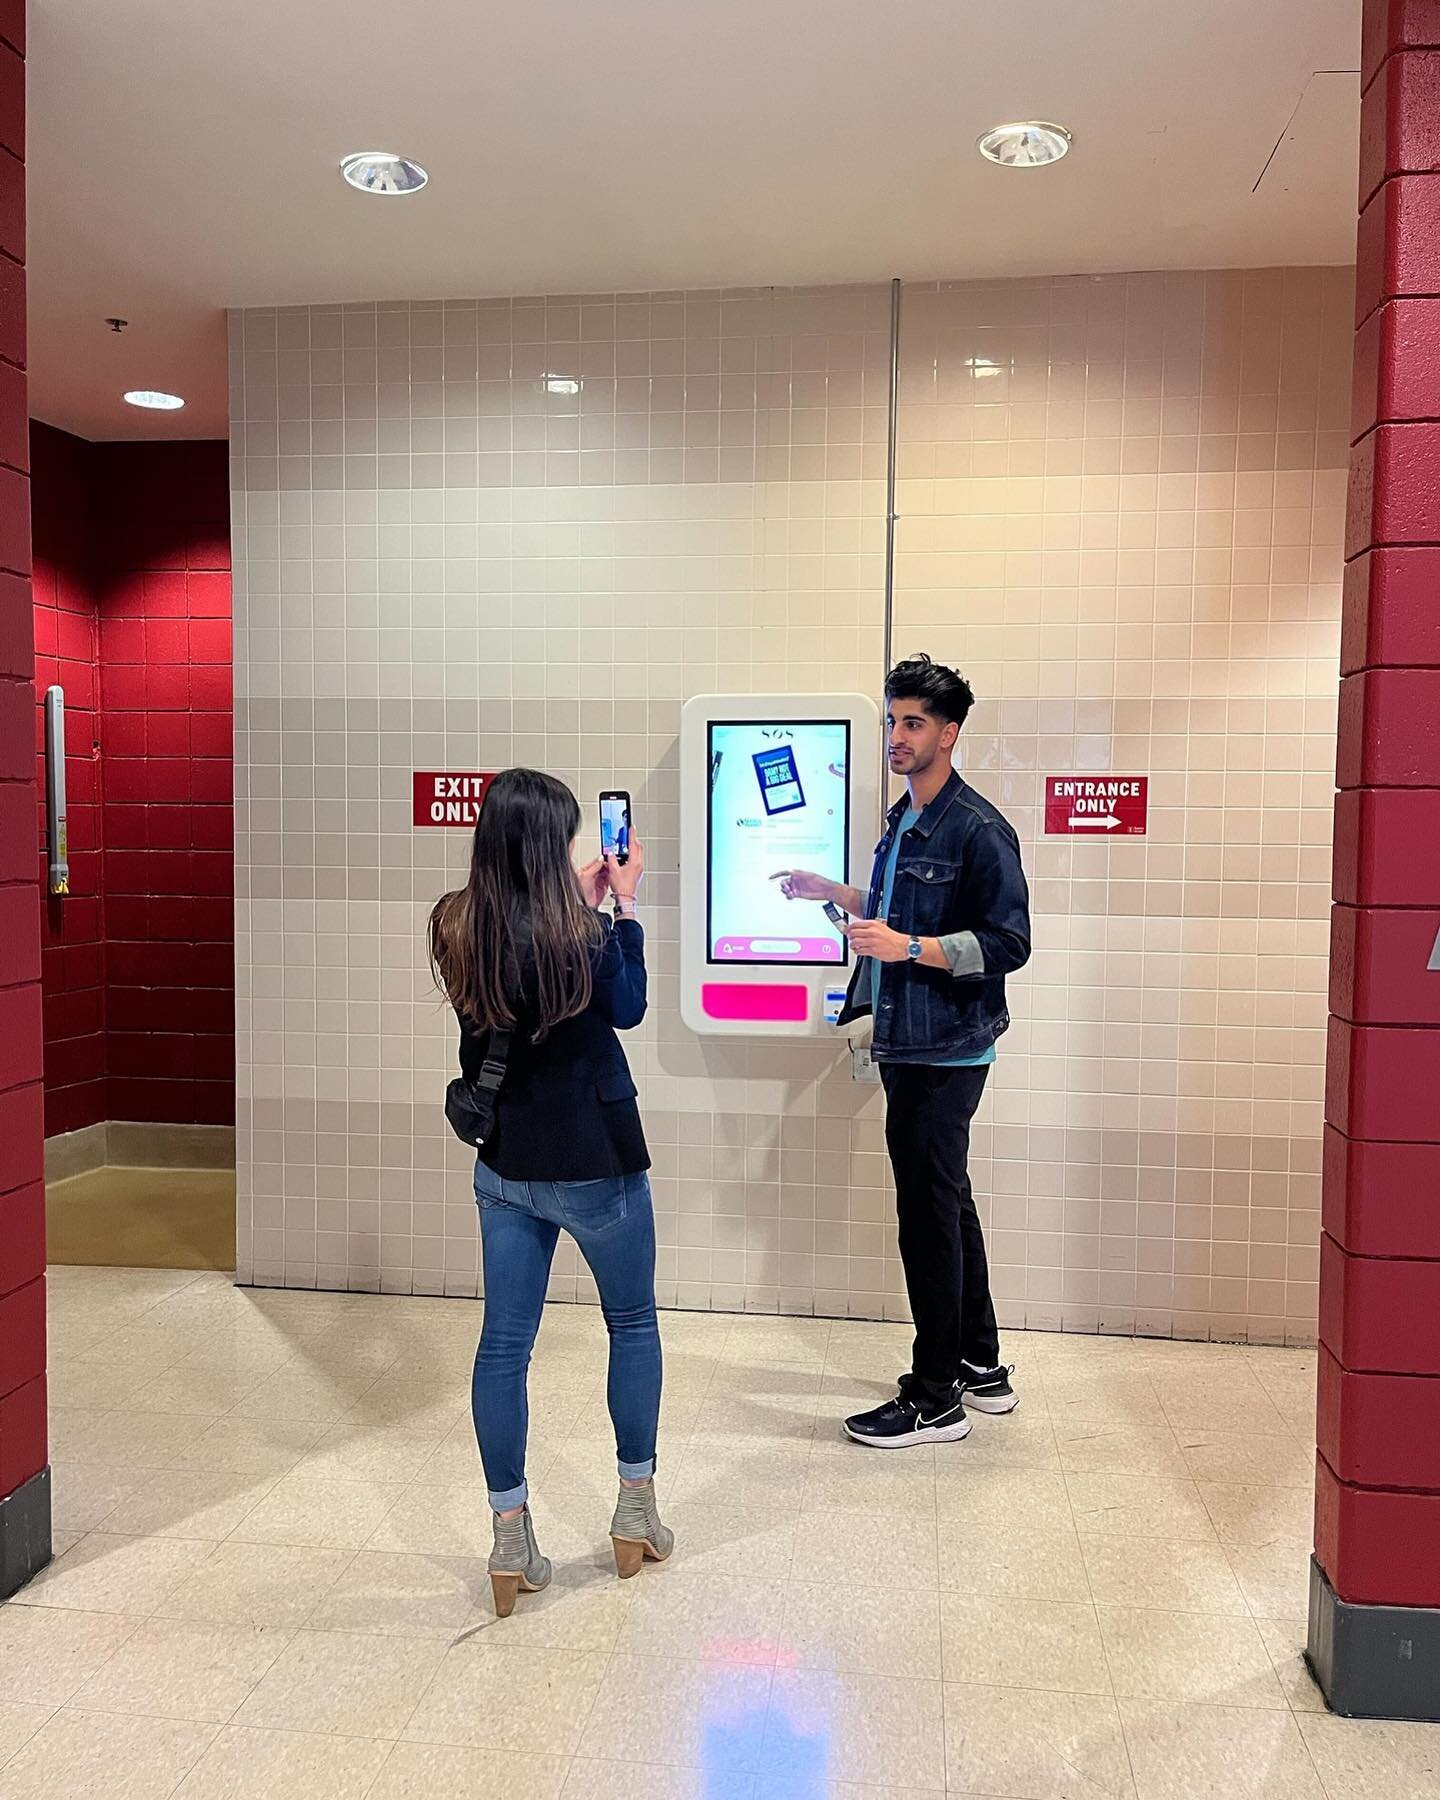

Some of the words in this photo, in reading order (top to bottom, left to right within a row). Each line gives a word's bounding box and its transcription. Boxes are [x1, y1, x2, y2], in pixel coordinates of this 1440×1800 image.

[434, 777, 484, 798] EXIT
[1054, 782, 1140, 797] ENTRANCE
[1075, 798, 1117, 813] ONLY
